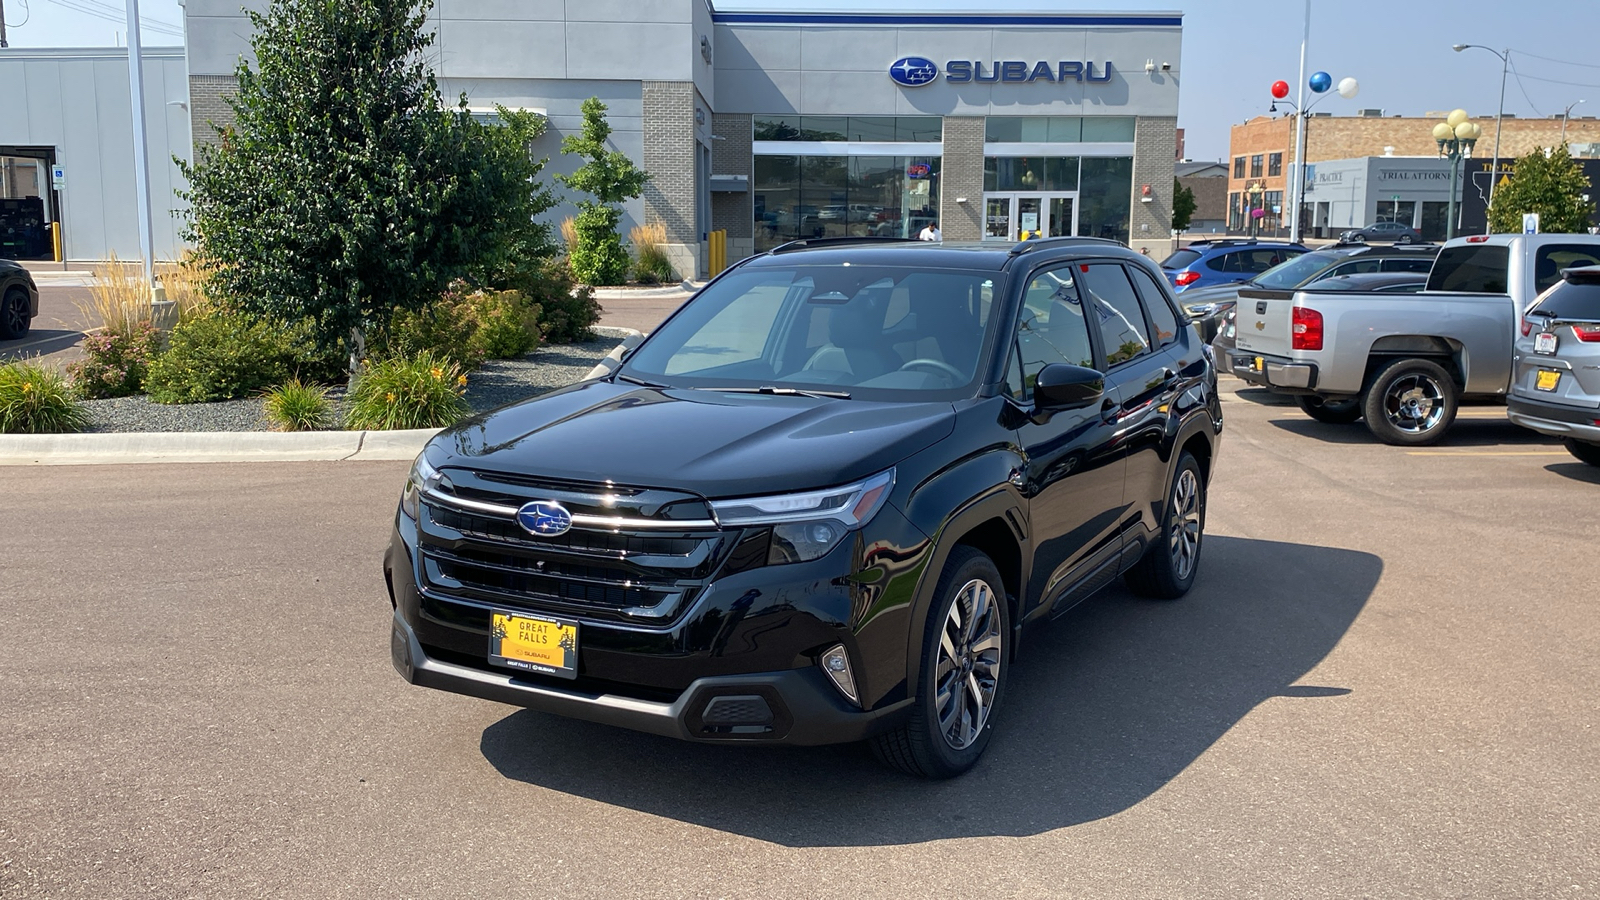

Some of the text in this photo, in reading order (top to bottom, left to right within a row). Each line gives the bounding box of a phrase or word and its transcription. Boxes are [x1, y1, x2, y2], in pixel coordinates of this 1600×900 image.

[946, 60, 1112, 83] SUBARU
[1382, 172, 1464, 180] TRIAL ATTORNES
[519, 621, 548, 633] GREAT
[519, 631, 548, 644] FALLS
[524, 651, 550, 660] SUBARU
